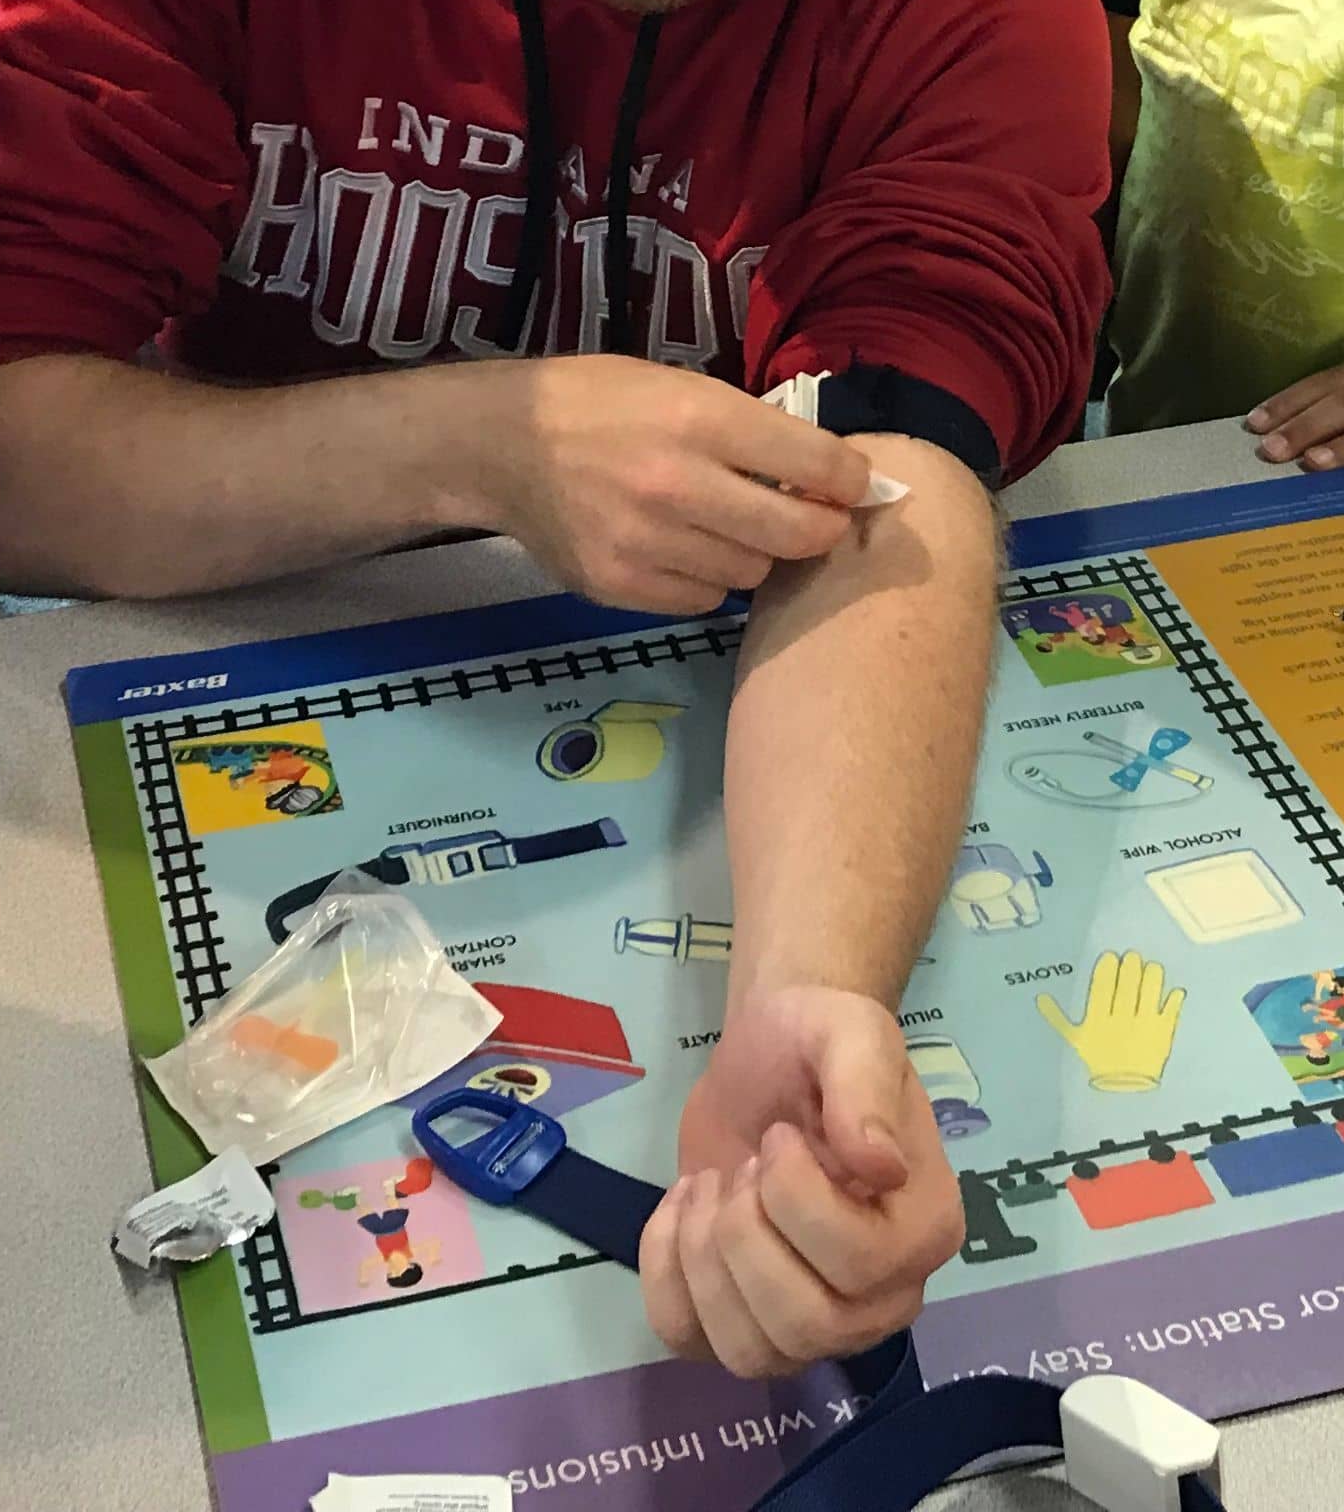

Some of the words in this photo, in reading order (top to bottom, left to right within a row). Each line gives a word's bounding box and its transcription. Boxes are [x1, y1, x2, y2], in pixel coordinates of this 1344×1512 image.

[116, 671, 230, 704] Baxter
[542, 697, 583, 714] TAPE
[1065, 700, 1145, 723] BUTTERFLY
[1002, 712, 1061, 733] NEEDLE
[386, 807, 497, 836] TOURNIQUET
[1119, 843, 1162, 859] WIPE
[1163, 827, 1243, 850] ALCOHOL
[1003, 962, 1073, 985] GLOVES
[1124, 1301, 1285, 1355] Station:
[1026, 1340, 1113, 1378] Stay
[717, 1408, 815, 1453] with
[505, 1431, 705, 1495] Infusions
